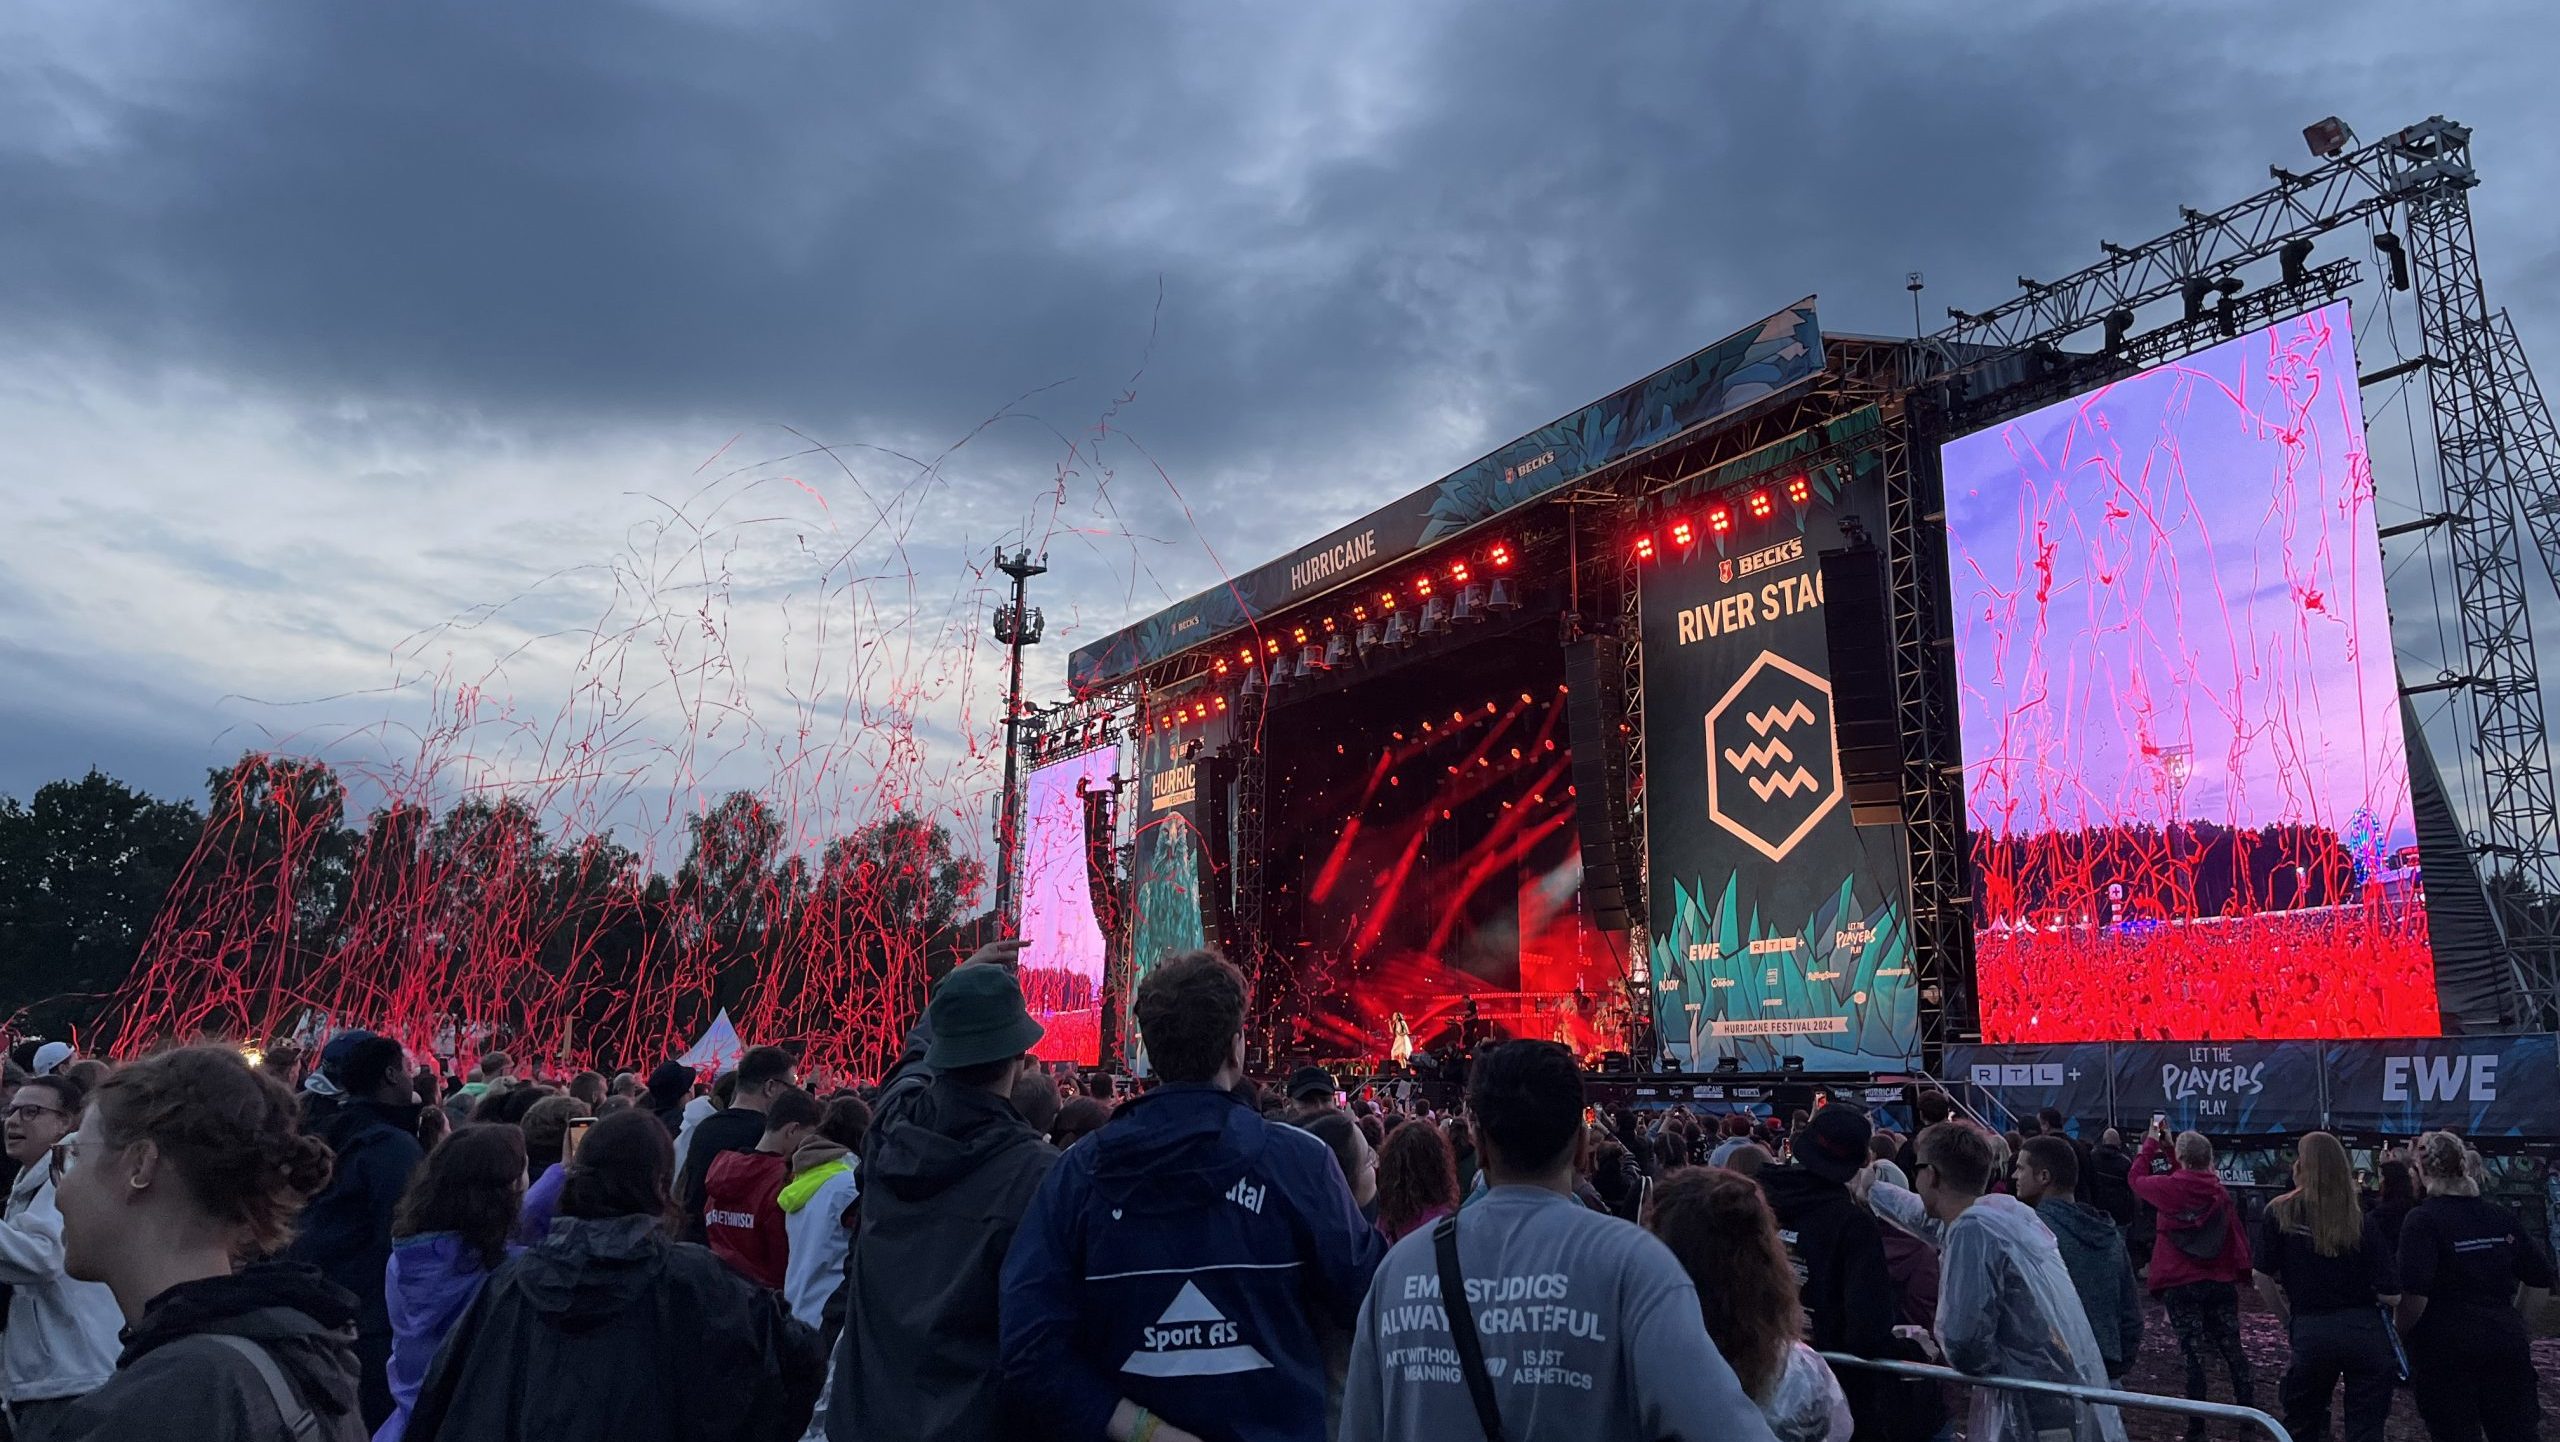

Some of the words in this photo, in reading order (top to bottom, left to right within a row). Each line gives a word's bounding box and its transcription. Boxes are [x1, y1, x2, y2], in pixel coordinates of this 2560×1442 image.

[1291, 529, 1377, 591] HURRICANE
[1739, 539, 1803, 576] BECK'S
[1678, 592, 1757, 646] RIVER
[1761, 569, 1825, 621] STA
[1152, 763, 1196, 798] HURRIC
[1689, 943, 1720, 960] EWE
[1836, 928, 1877, 949] PLAYERS
[1724, 1023, 1769, 1034] HURRICANE
[1771, 1021, 1811, 1032] FESTIVAL
[1813, 1020, 1833, 1031] 2024
[2189, 1048, 2209, 1063] LET
[2213, 1048, 2232, 1063] THE
[2162, 1062, 2265, 1101] PLAYERS
[2382, 1055, 2499, 1101] EWE
[2199, 1100, 2227, 1116] PLAY
[1404, 1275, 1442, 1300] EM
[1463, 1272, 1569, 1304] STUDIOS
[1144, 1324, 1202, 1352] Sport
[1209, 1321, 1239, 1346] AS
[1381, 1304, 1450, 1339] ALWAY
[1479, 1304, 1606, 1342] GRATEFUL
[1386, 1348, 1406, 1369] ART
[1407, 1346, 1461, 1366] WITHOU
[1523, 1349, 1537, 1366] IS
